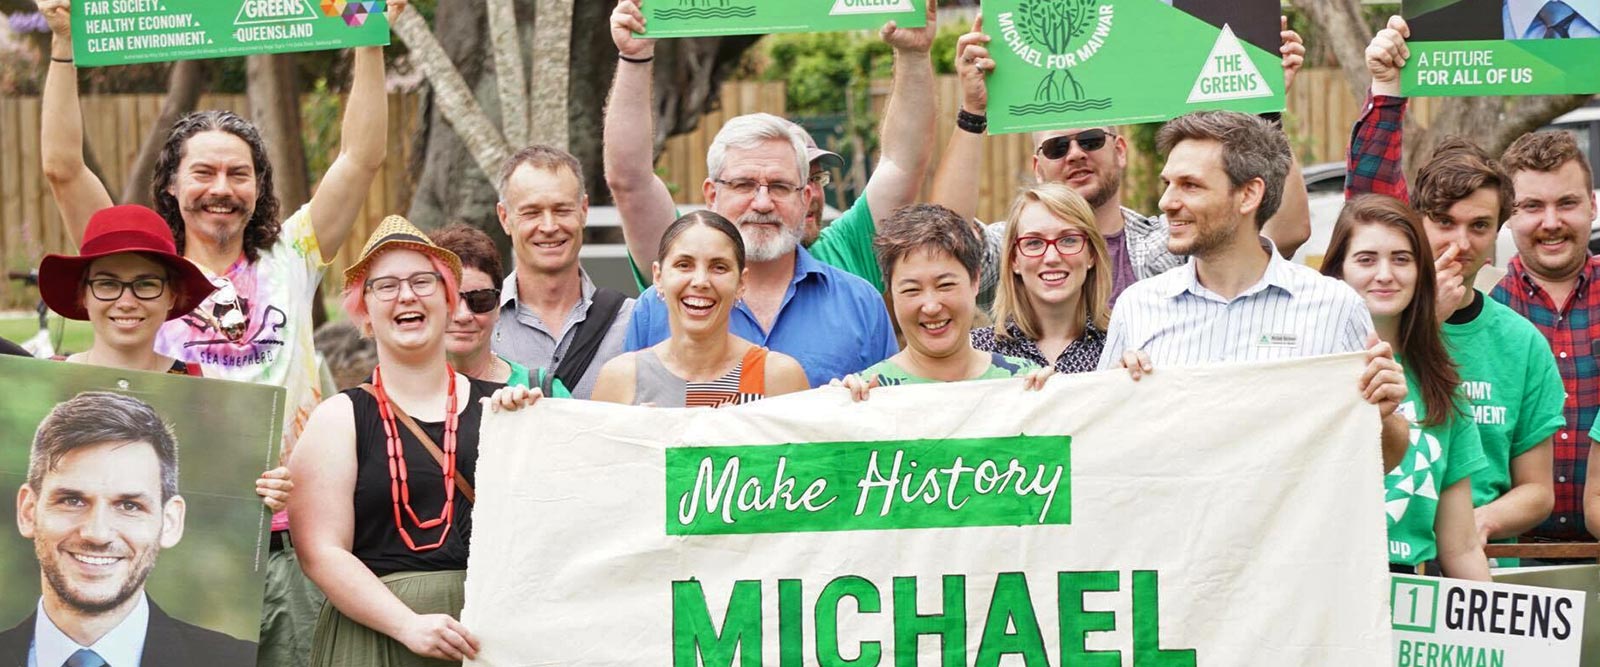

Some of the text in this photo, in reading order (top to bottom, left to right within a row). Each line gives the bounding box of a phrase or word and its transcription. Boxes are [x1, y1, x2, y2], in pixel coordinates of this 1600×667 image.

[84, 0, 159, 16] FAIR SOCIETY
[245, 0, 305, 18] GREENS
[86, 13, 193, 34] HEALTHY ECONOMY
[237, 23, 314, 42] QUEENSLAND
[88, 36, 125, 53] CLEAN
[127, 31, 206, 50] ENVIRONMENT
[998, 4, 1114, 69] MICHAEL FOR MAIWAR
[1214, 54, 1242, 73] THE
[1417, 50, 1494, 67] A FUTURE
[1200, 72, 1258, 95] GREENS
[1417, 67, 1533, 86] FOR ALL OF US
[201, 350, 273, 368] SEA SHEPHERD
[678, 449, 1064, 526] Make History
[1390, 540, 1411, 560] up
[671, 570, 1197, 667] MICHAEL
[1408, 586, 1573, 641] 1 GREENS
[1397, 640, 1505, 667] BERKMAN
